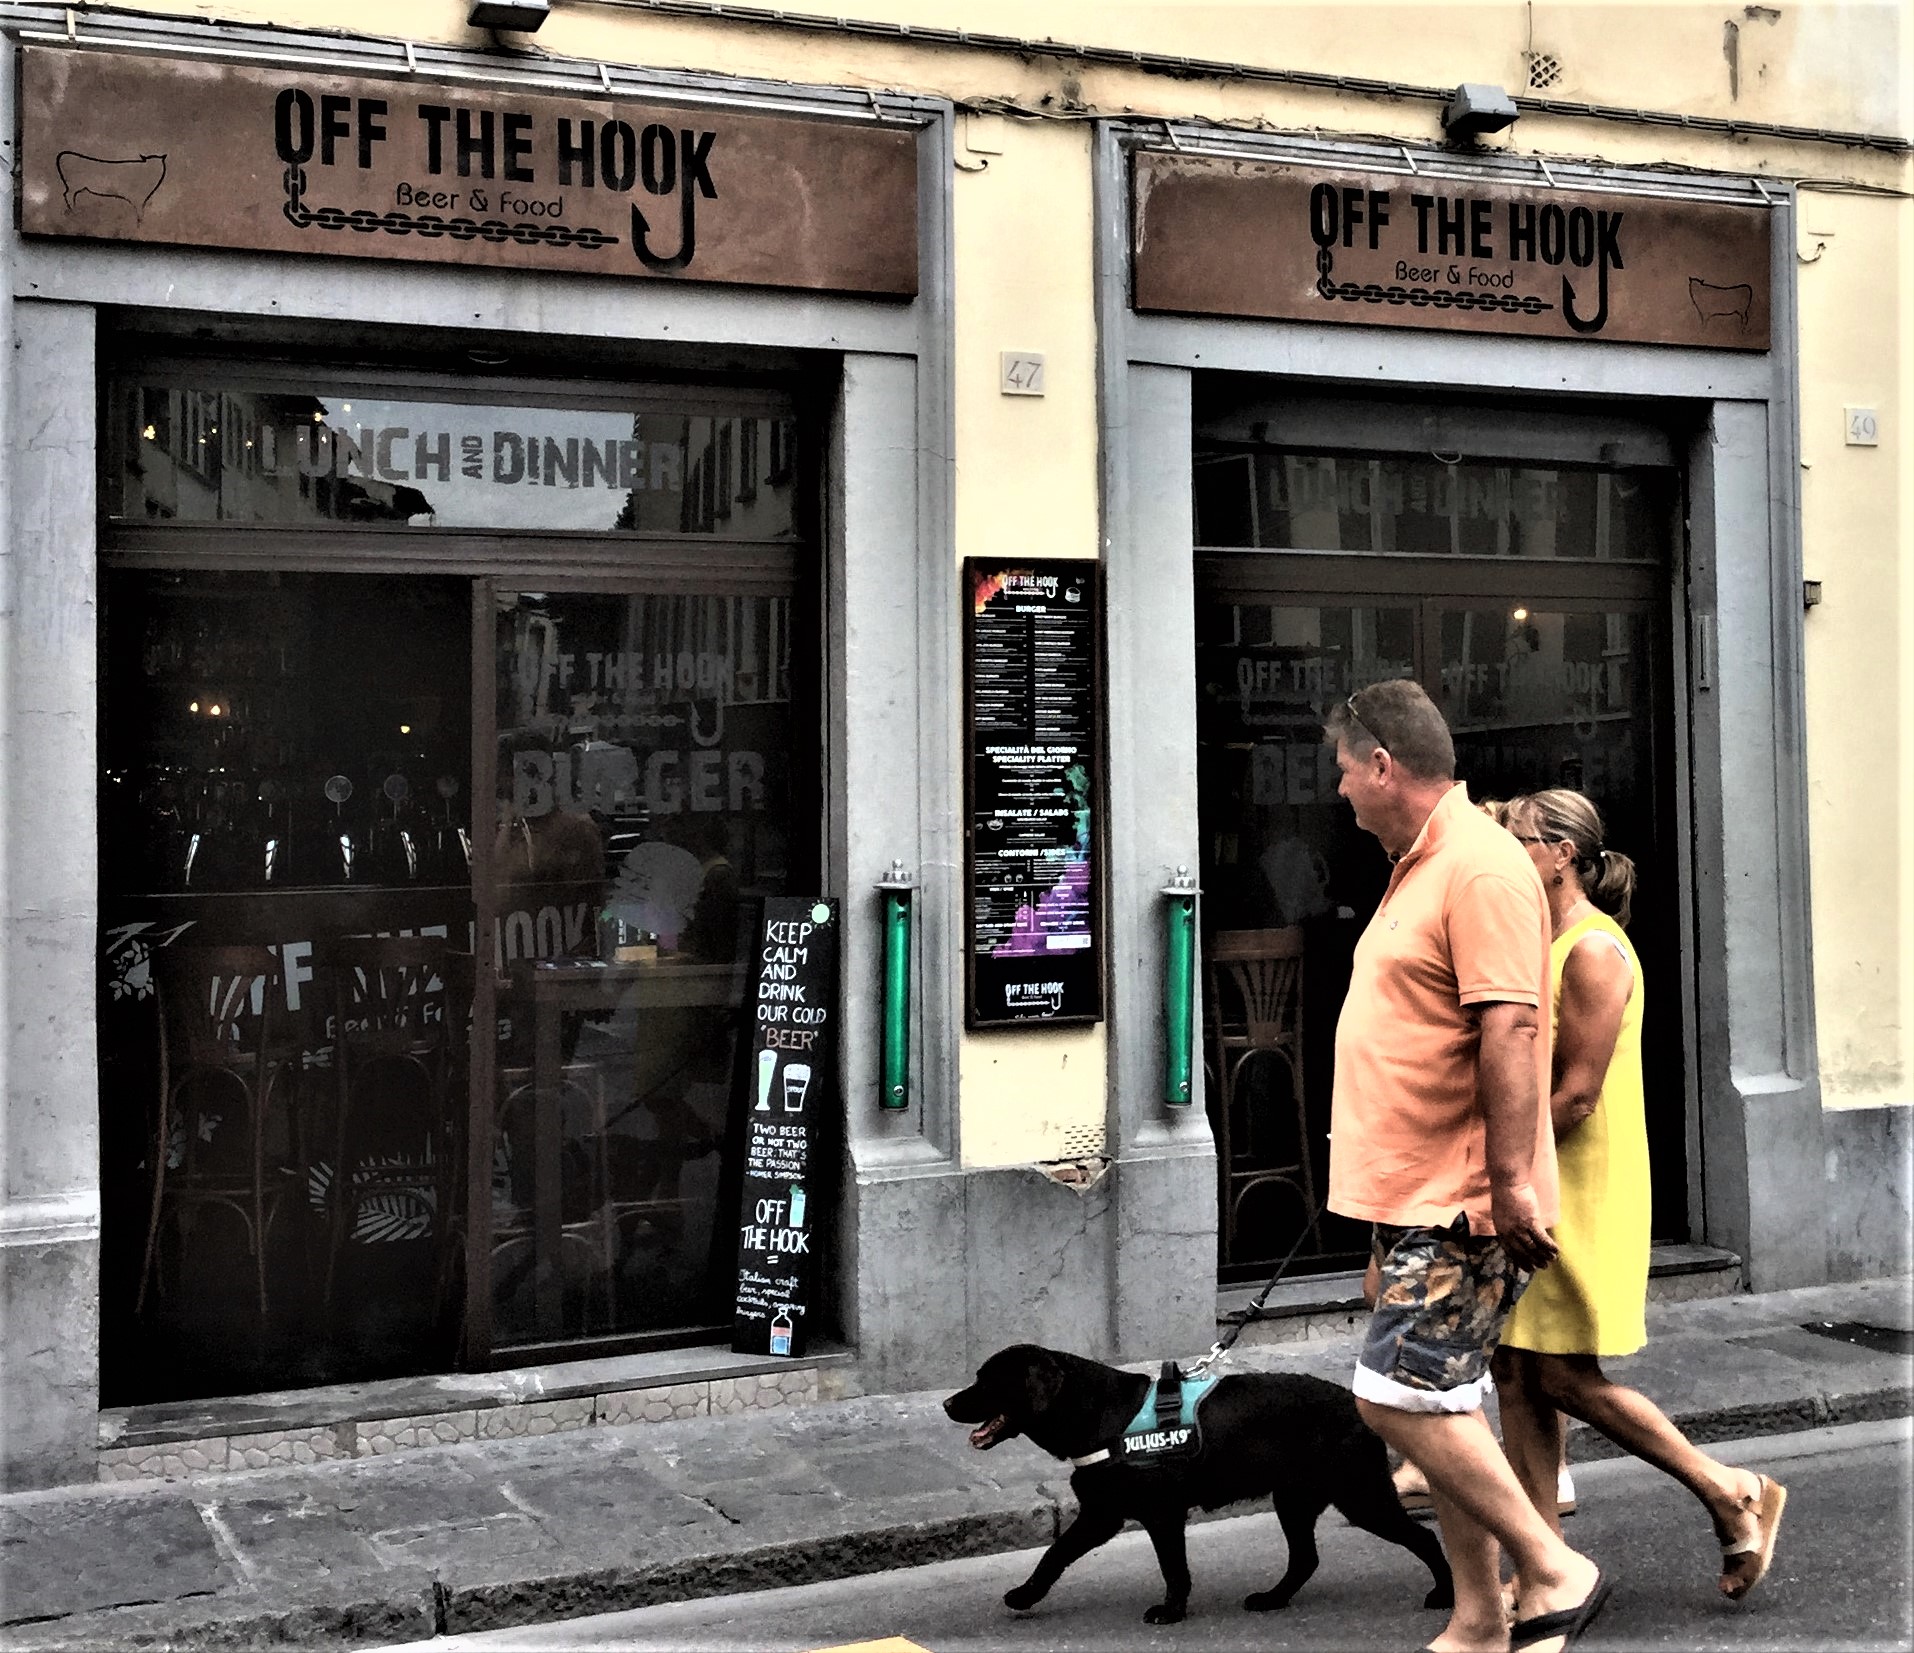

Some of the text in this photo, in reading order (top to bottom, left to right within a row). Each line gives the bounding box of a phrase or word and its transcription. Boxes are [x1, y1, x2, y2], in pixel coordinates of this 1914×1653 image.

[275, 88, 718, 214] OFF THE HOOK
[396, 182, 563, 219] Beer & Food
[1309, 182, 1625, 284] OFF THE HOOK
[1395, 260, 1515, 289] Beer & Food
[1007, 360, 1041, 389] 47
[261, 424, 681, 490] LUNCH AND DINNER
[1019, 575, 1035, 587] THE
[766, 919, 813, 945] KEEP
[762, 946, 808, 965] CALM
[760, 963, 797, 980] AND
[758, 982, 806, 1003] DRINK
[1005, 983, 1021, 995] OFF
[1023, 982, 1040, 995] THE
[1040, 981, 1064, 997] HOOK
[757, 1004, 827, 1024] OUR COLD
[751, 1135, 807, 1150] OR NOT TWO
[779, 1125, 807, 1138] BEER
[747, 1157, 764, 1168] THE
[755, 1198, 787, 1226] OFF
[740, 1224, 811, 1254] THE HOOK
[775, 1275, 800, 1291] craft
[1124, 1429, 1188, 1454] JULIUS-K9
